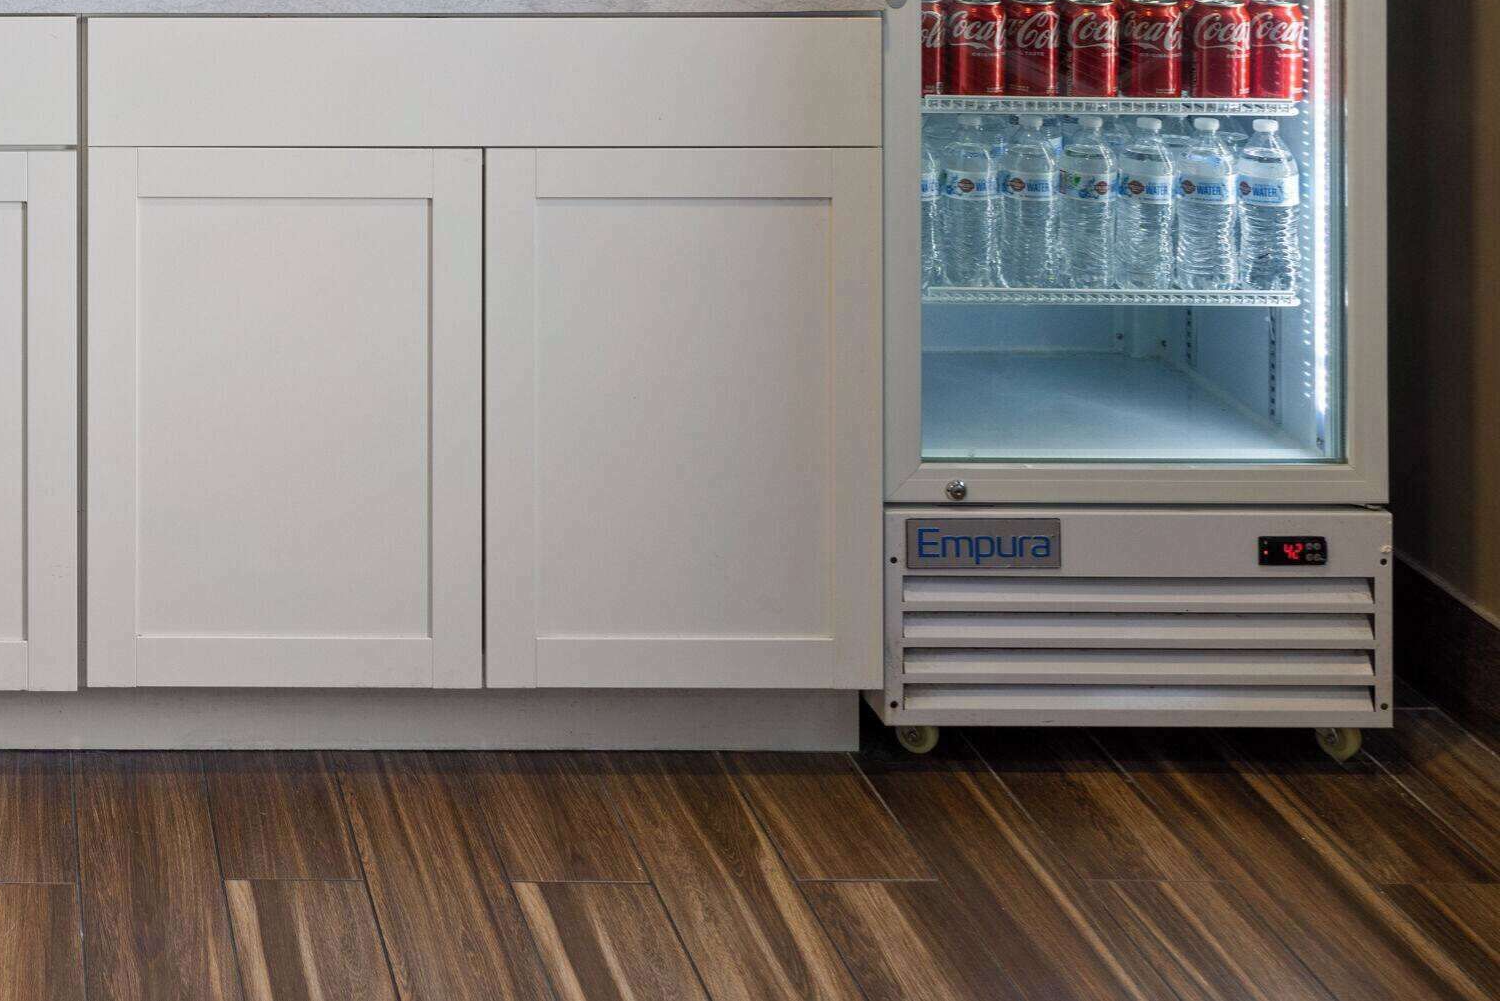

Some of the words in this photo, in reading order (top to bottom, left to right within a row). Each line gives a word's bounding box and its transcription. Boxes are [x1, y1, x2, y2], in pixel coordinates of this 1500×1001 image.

[1197, 185, 1222, 196] WATER
[1252, 186, 1278, 197] WATER
[917, 528, 1051, 565] Empura
